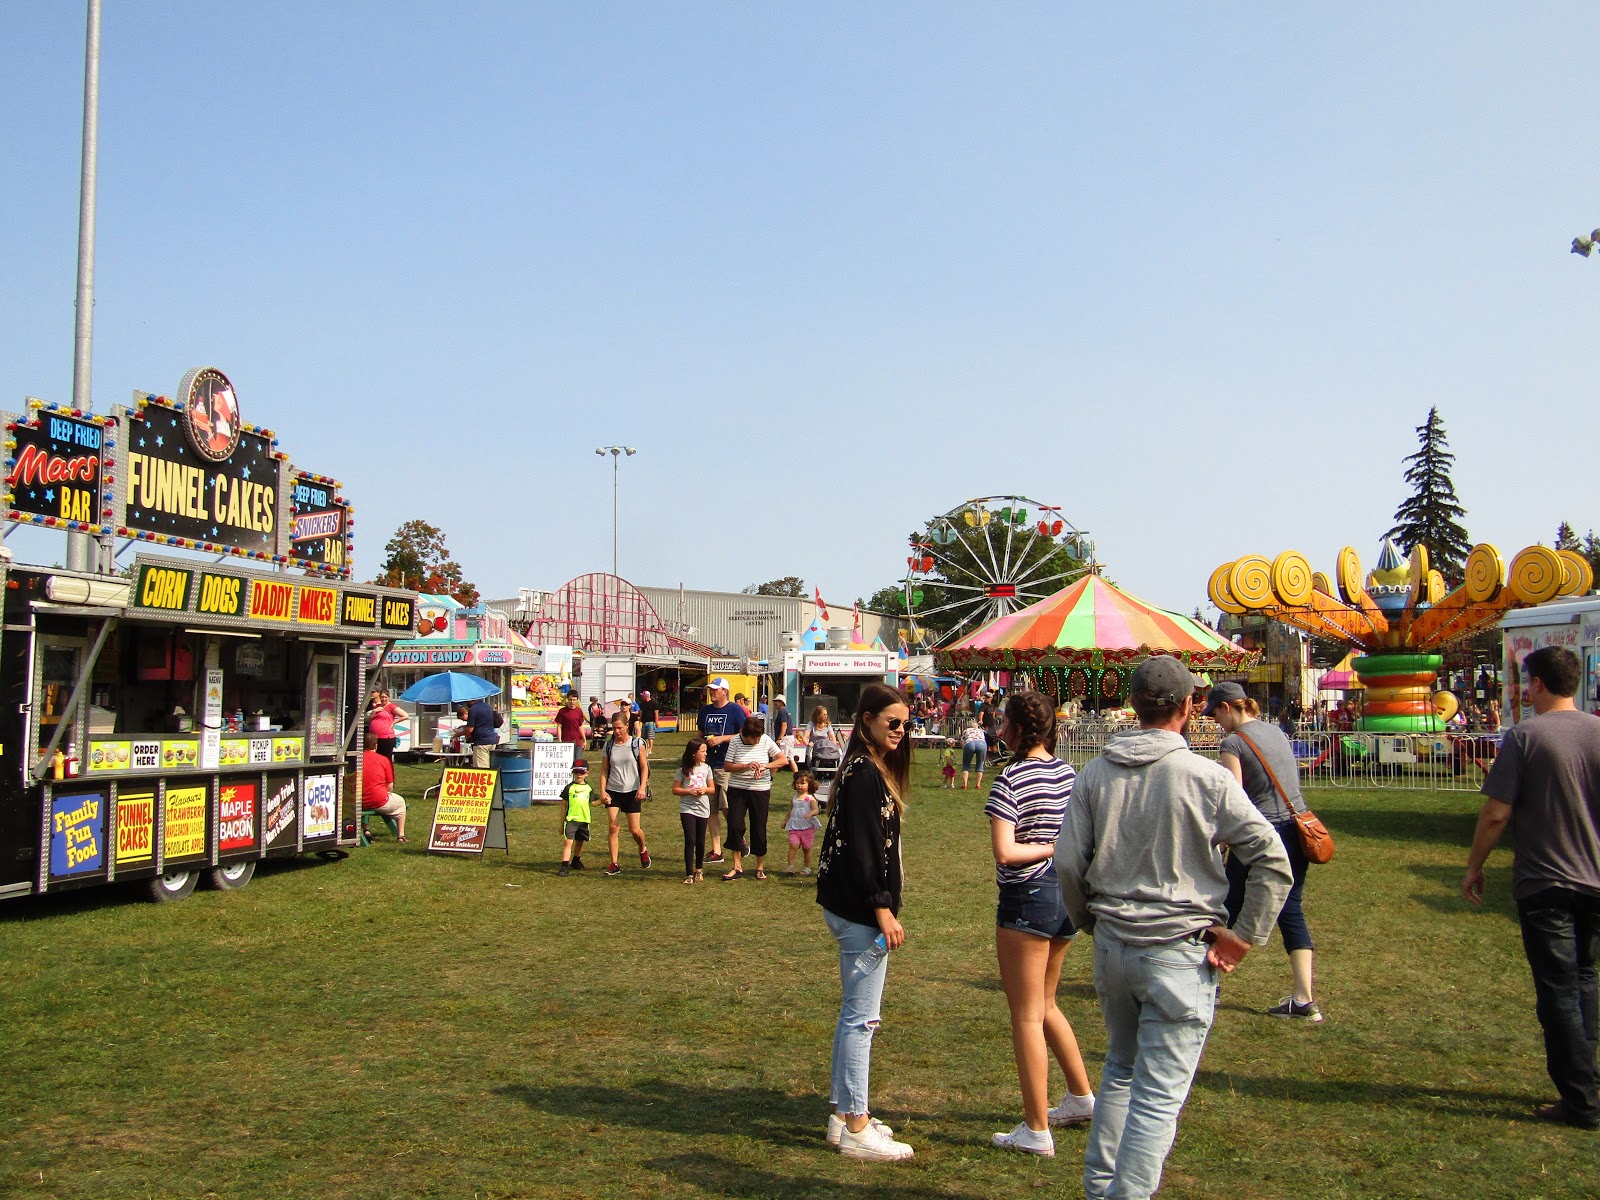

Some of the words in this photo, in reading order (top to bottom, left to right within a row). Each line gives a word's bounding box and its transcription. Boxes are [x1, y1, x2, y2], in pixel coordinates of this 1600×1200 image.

[50, 418, 72, 442] DEEP
[75, 424, 100, 449] FRIED
[11, 444, 98, 488] Mars
[127, 452, 208, 520] FUNNEL
[215, 473, 274, 533] CAKES
[296, 485, 310, 503] DEEP
[311, 488, 326, 507] FRIED
[60, 486, 90, 522] BAR
[296, 513, 338, 538] SNICKERS
[324, 538, 342, 564] BAR
[142, 568, 187, 609] CORN
[200, 575, 240, 614] DOGS
[252, 582, 292, 617] DADDY
[299, 589, 333, 621] MIKES
[345, 597, 375, 622] FUNNEL
[385, 601, 409, 625] CAKES
[386, 651, 427, 663] COTTON
[431, 651, 467, 663] CANDY
[134, 745, 158, 754] ORDER
[252, 740, 269, 750] PICKUP
[136, 757, 155, 765] HERE
[254, 752, 266, 761] HERE
[446, 771, 493, 785] FUNNEL
[169, 792, 202, 809] Flavours
[267, 794, 280, 813] deep
[281, 779, 295, 801] fried
[447, 784, 487, 798] CAKES
[222, 800, 252, 818] MAPLE
[441, 798, 490, 807] STRAWBERRY
[54, 800, 99, 832] Family
[118, 802, 152, 828] FUNNEL
[166, 806, 206, 822] STRAWBERRY
[437, 814, 467, 822] CHOCOLATE
[65, 825, 92, 848] Fun
[120, 826, 149, 852] CAKES
[220, 819, 254, 840] BACON
[66, 837, 98, 868] Food
[165, 840, 189, 856] CHOCOLATE
[191, 838, 204, 852] APPLE
